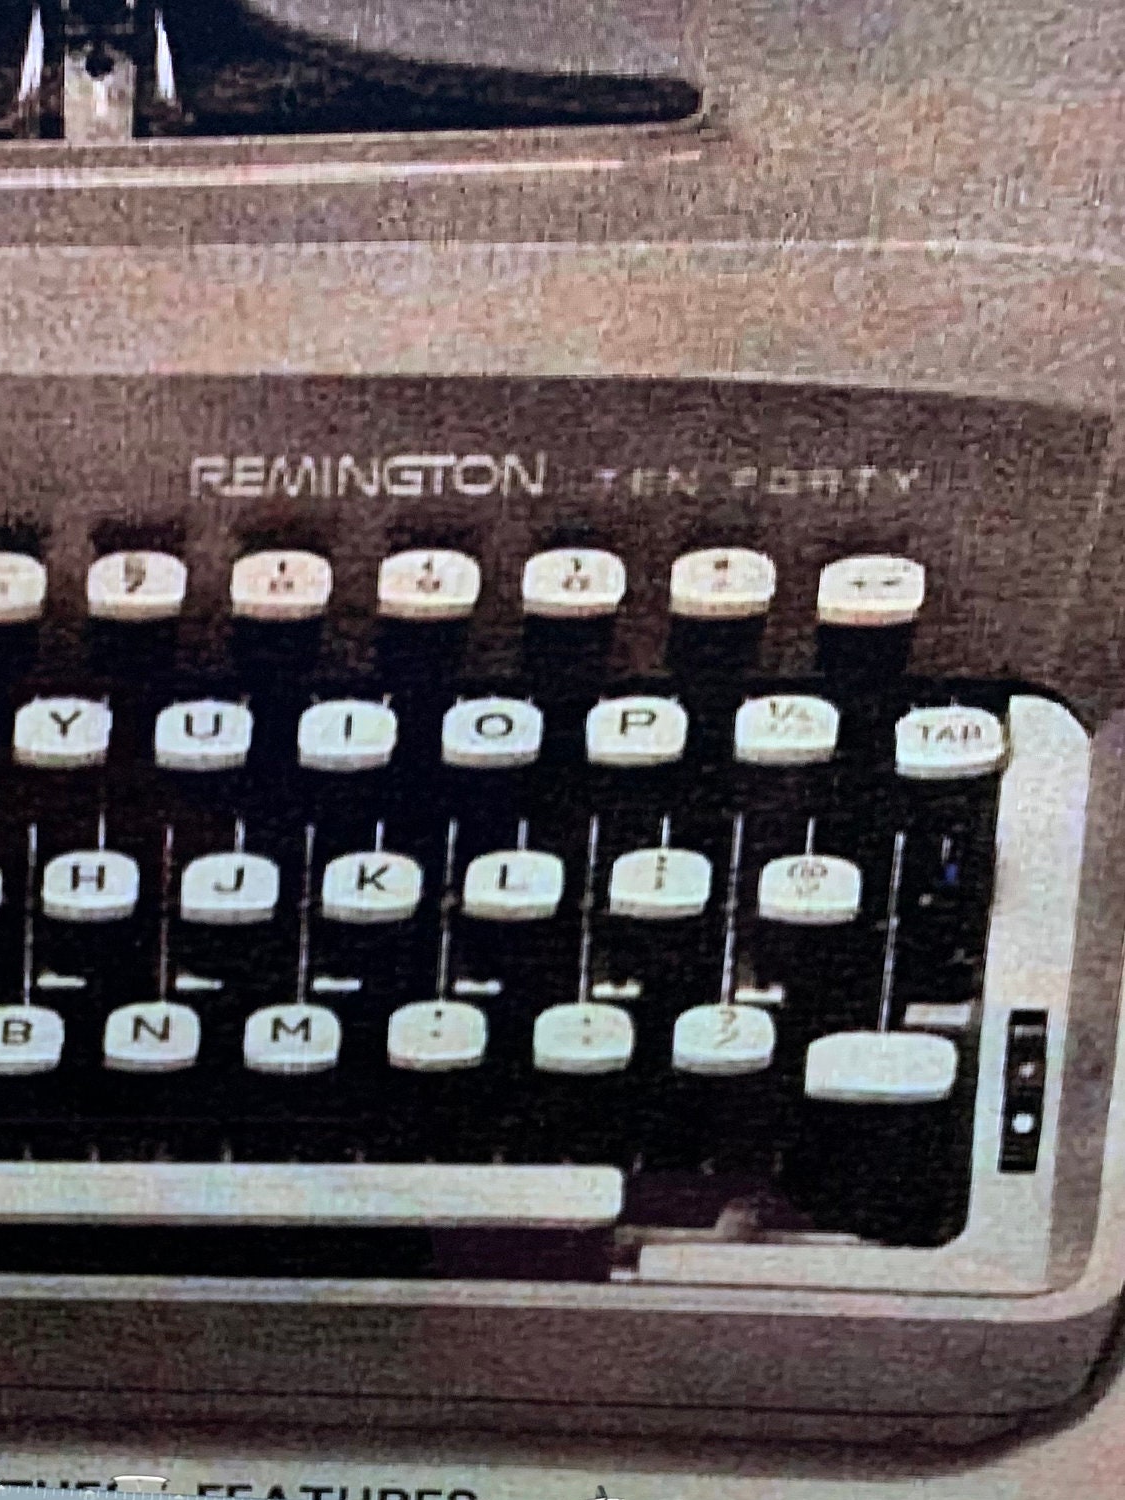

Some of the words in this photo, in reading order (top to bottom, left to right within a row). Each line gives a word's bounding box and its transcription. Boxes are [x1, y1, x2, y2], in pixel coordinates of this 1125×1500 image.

[190, 451, 547, 499] REMINGTON
[49, 710, 82, 738] Y
[184, 713, 223, 737] U
[474, 713, 514, 737] O
[619, 710, 657, 735] P
[71, 864, 106, 891] H
[214, 866, 245, 892] J
[356, 864, 388, 891] K
[497, 864, 519, 891] L
[1, 1018, 33, 1046] B
[132, 1015, 171, 1043] N
[270, 1016, 312, 1043] M
